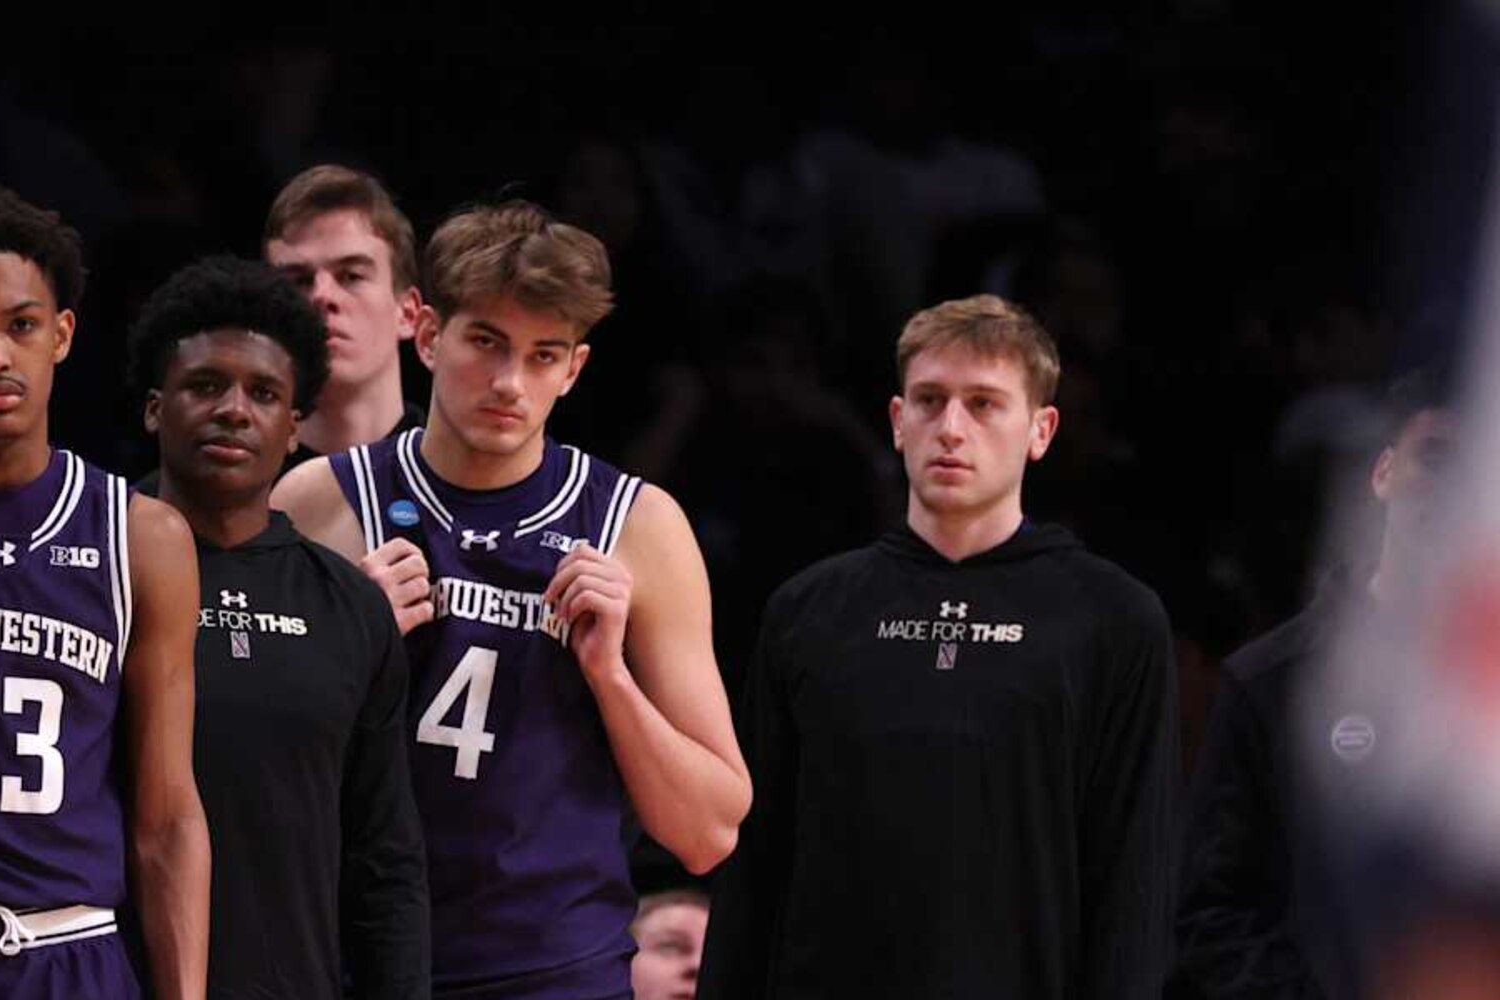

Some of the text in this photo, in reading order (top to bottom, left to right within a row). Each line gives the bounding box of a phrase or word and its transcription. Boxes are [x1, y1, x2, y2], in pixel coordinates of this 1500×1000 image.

[218, 609, 253, 630] FOR
[254, 612, 308, 636] THIS
[877, 620, 1024, 643] MADE FOR THIS
[416, 645, 498, 779] 4
